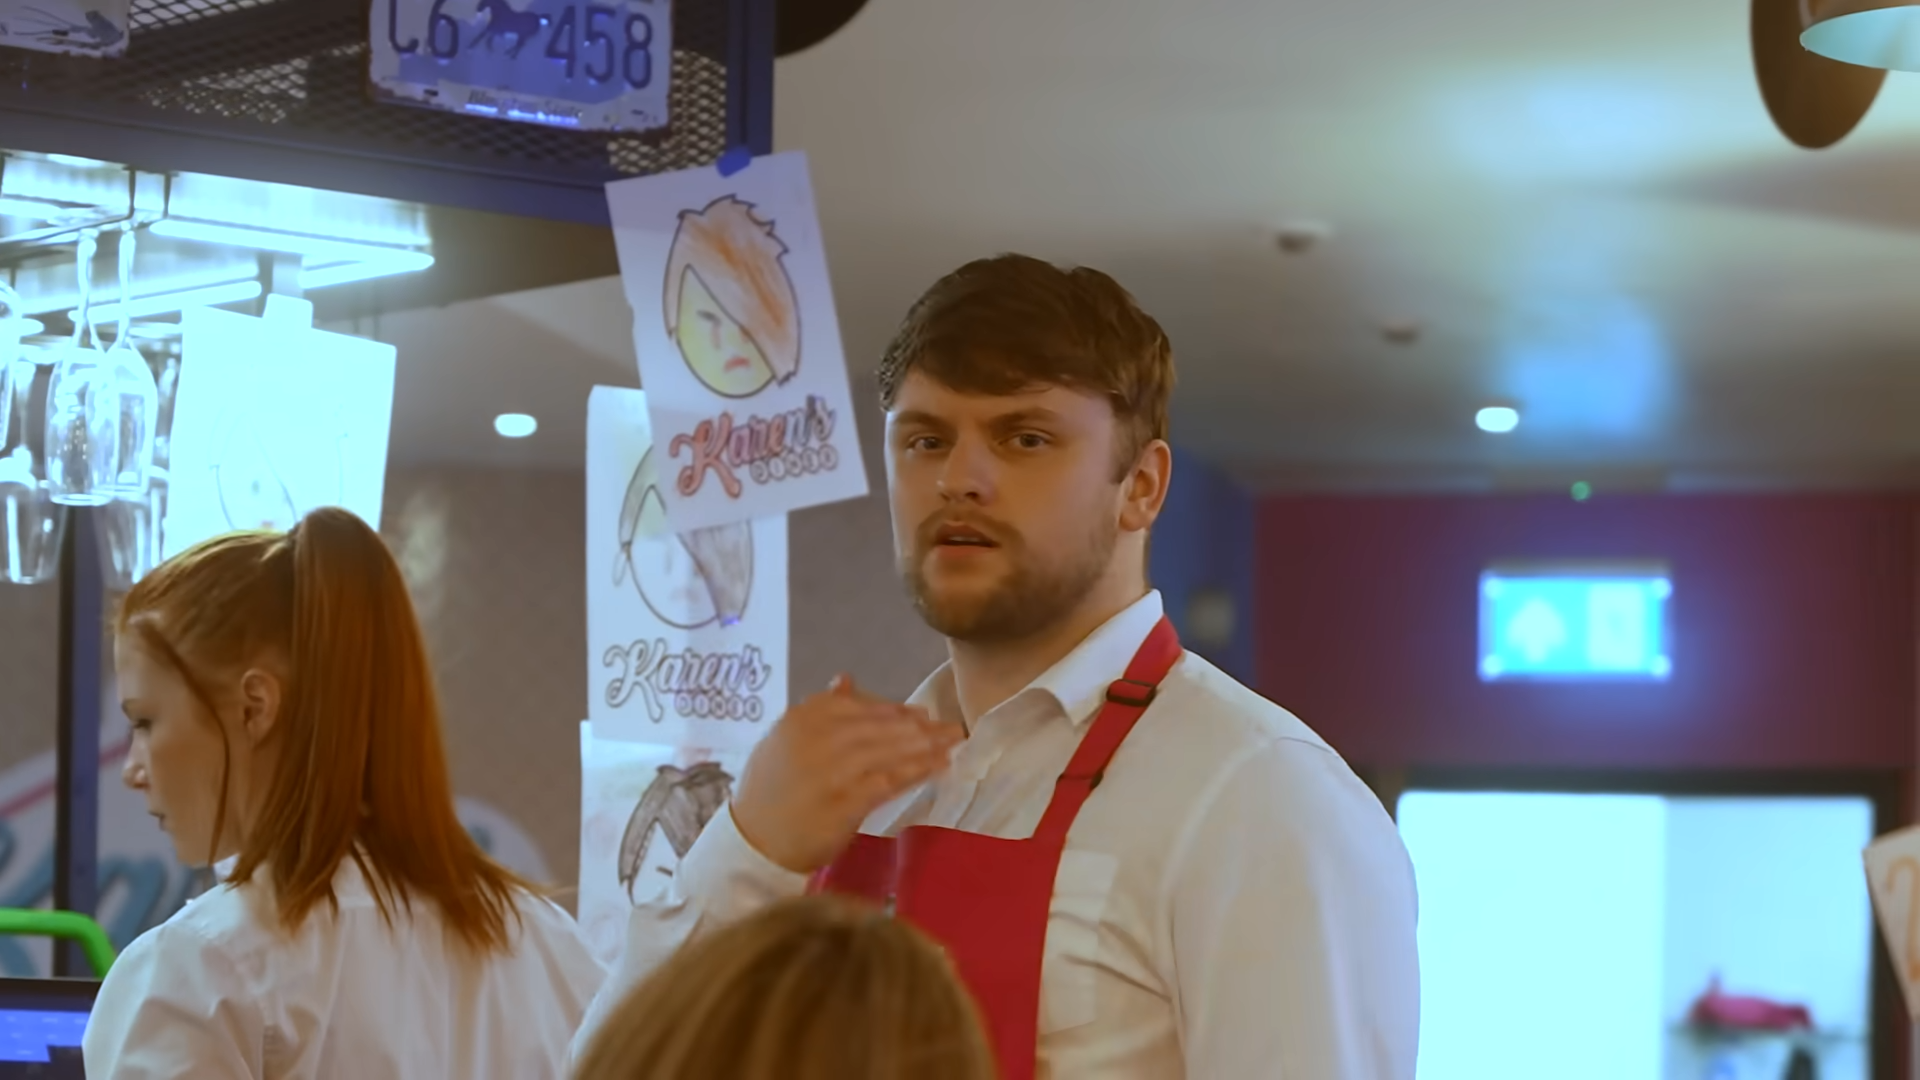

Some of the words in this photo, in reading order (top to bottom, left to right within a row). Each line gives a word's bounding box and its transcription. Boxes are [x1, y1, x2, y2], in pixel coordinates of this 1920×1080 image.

[544, 5, 653, 90] 458
[669, 395, 836, 499] Karen's
[603, 637, 772, 723] Karen's
